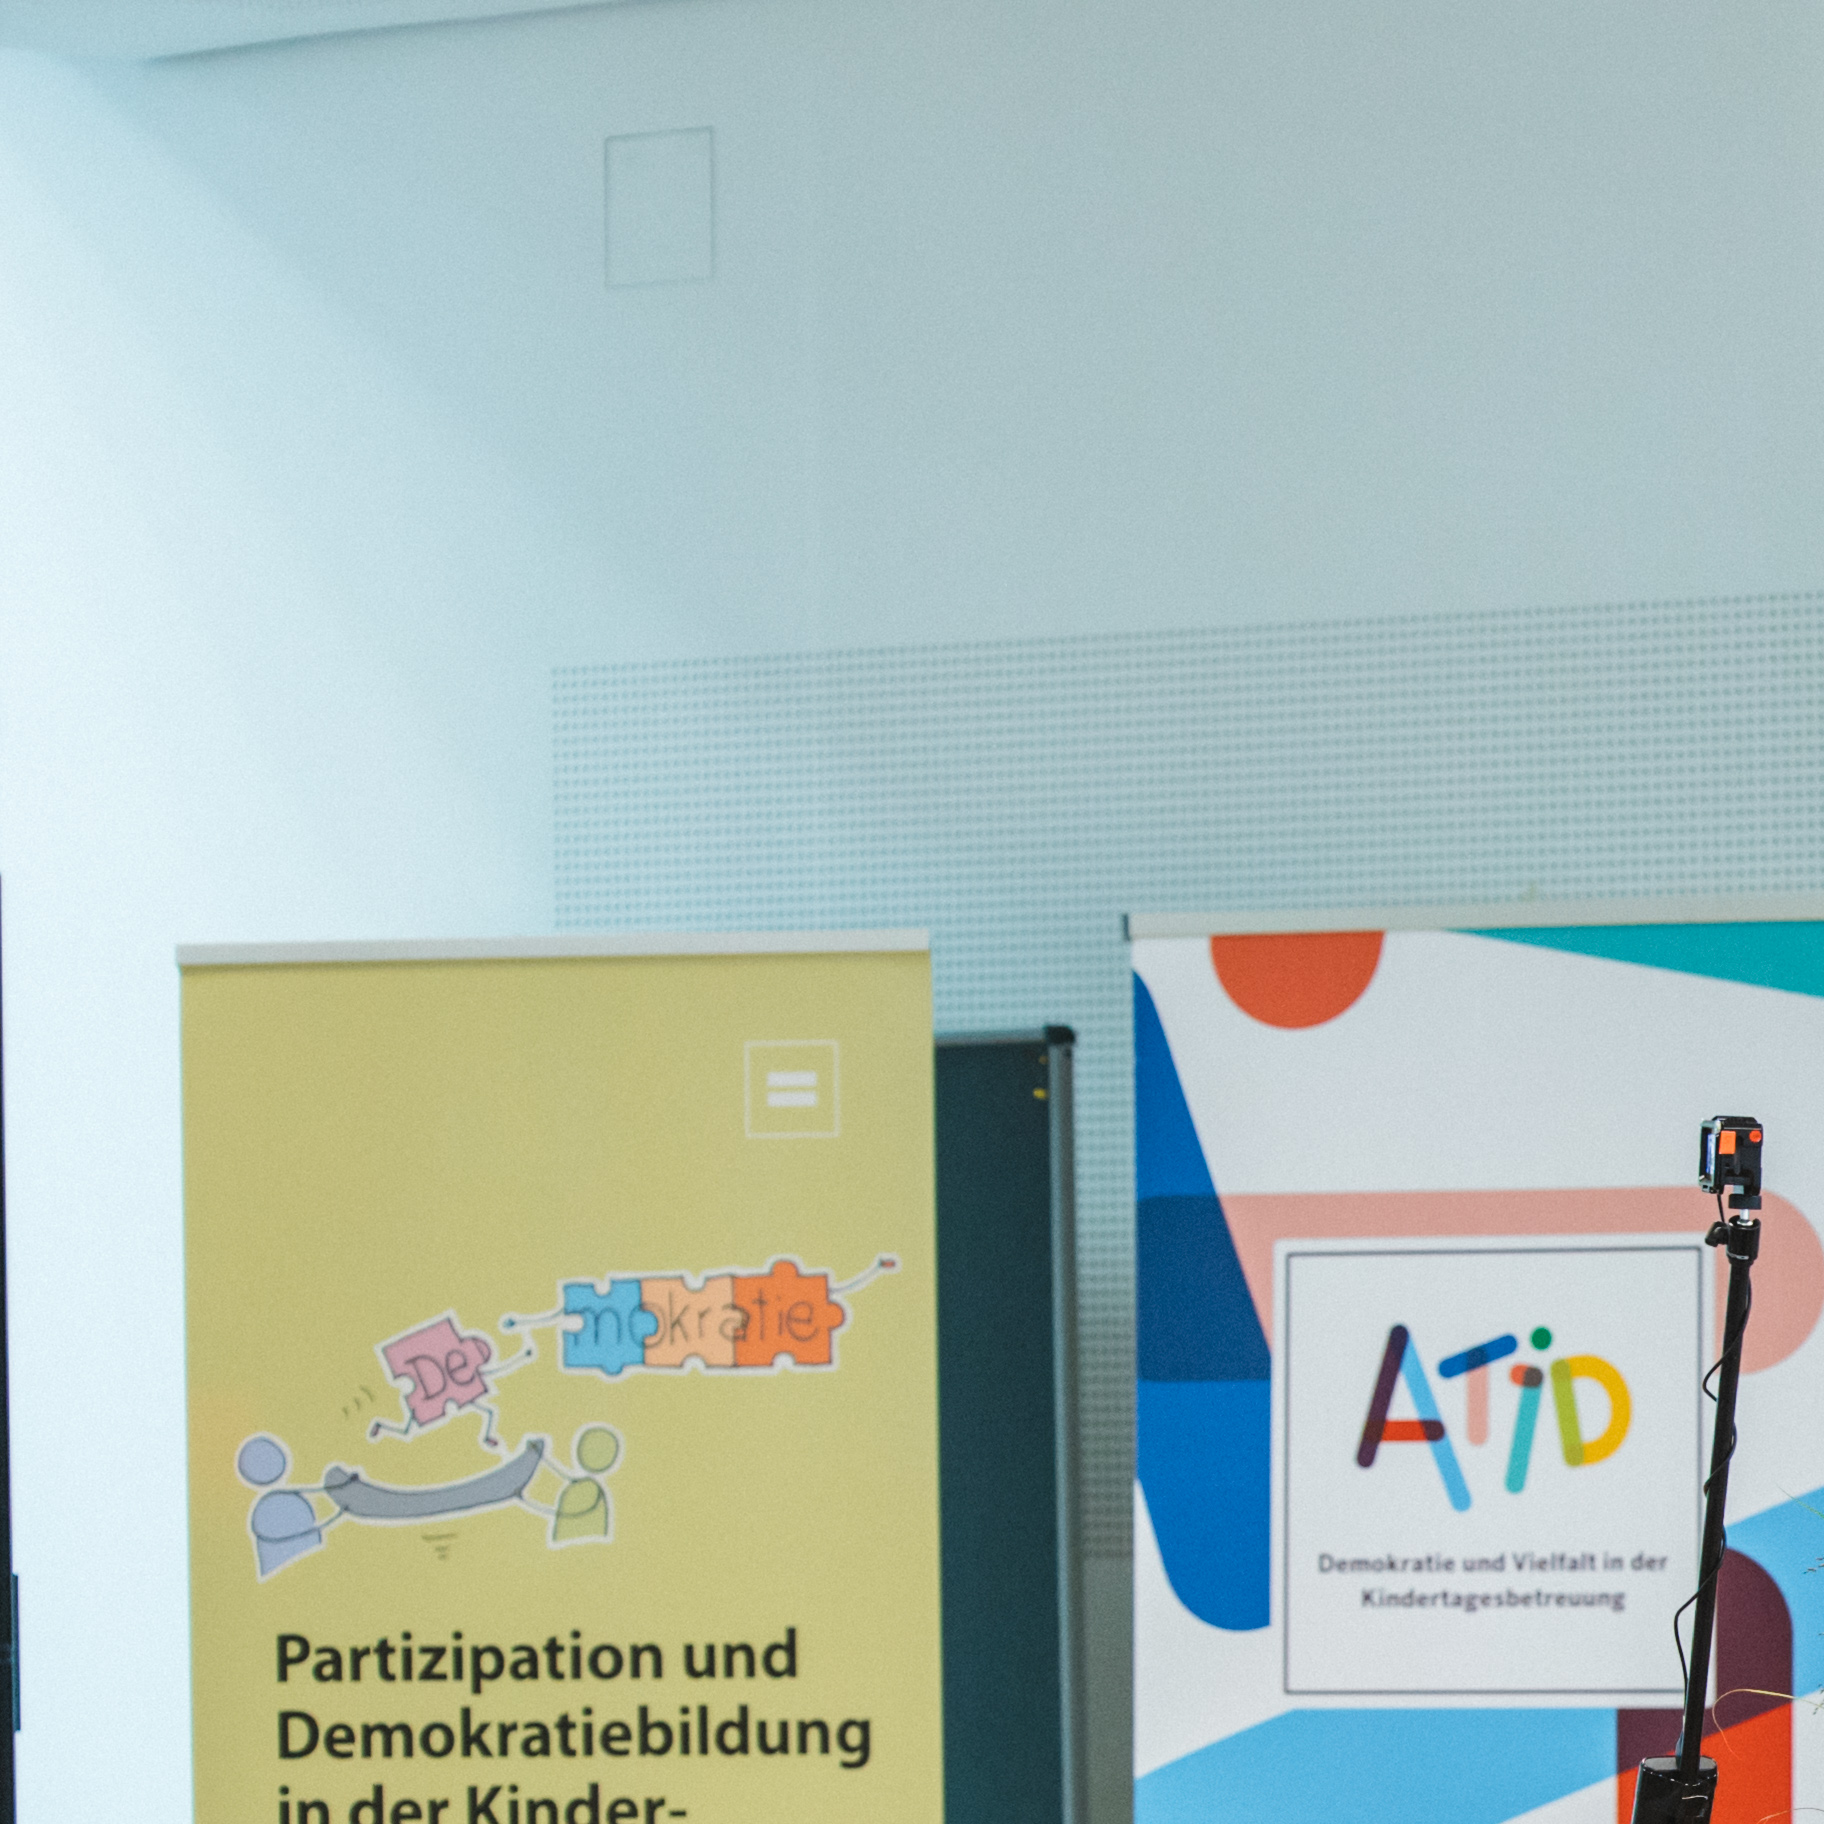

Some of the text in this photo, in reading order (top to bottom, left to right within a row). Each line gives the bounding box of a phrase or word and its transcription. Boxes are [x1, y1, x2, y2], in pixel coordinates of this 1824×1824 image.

[1318, 1552, 1668, 1574] Demokratie und Vielfalt in der
[1361, 1590, 1625, 1612] Kindertagesbetreuung
[277, 1627, 797, 1694] Partizipation und
[279, 1705, 870, 1768] Demokratiebildung
